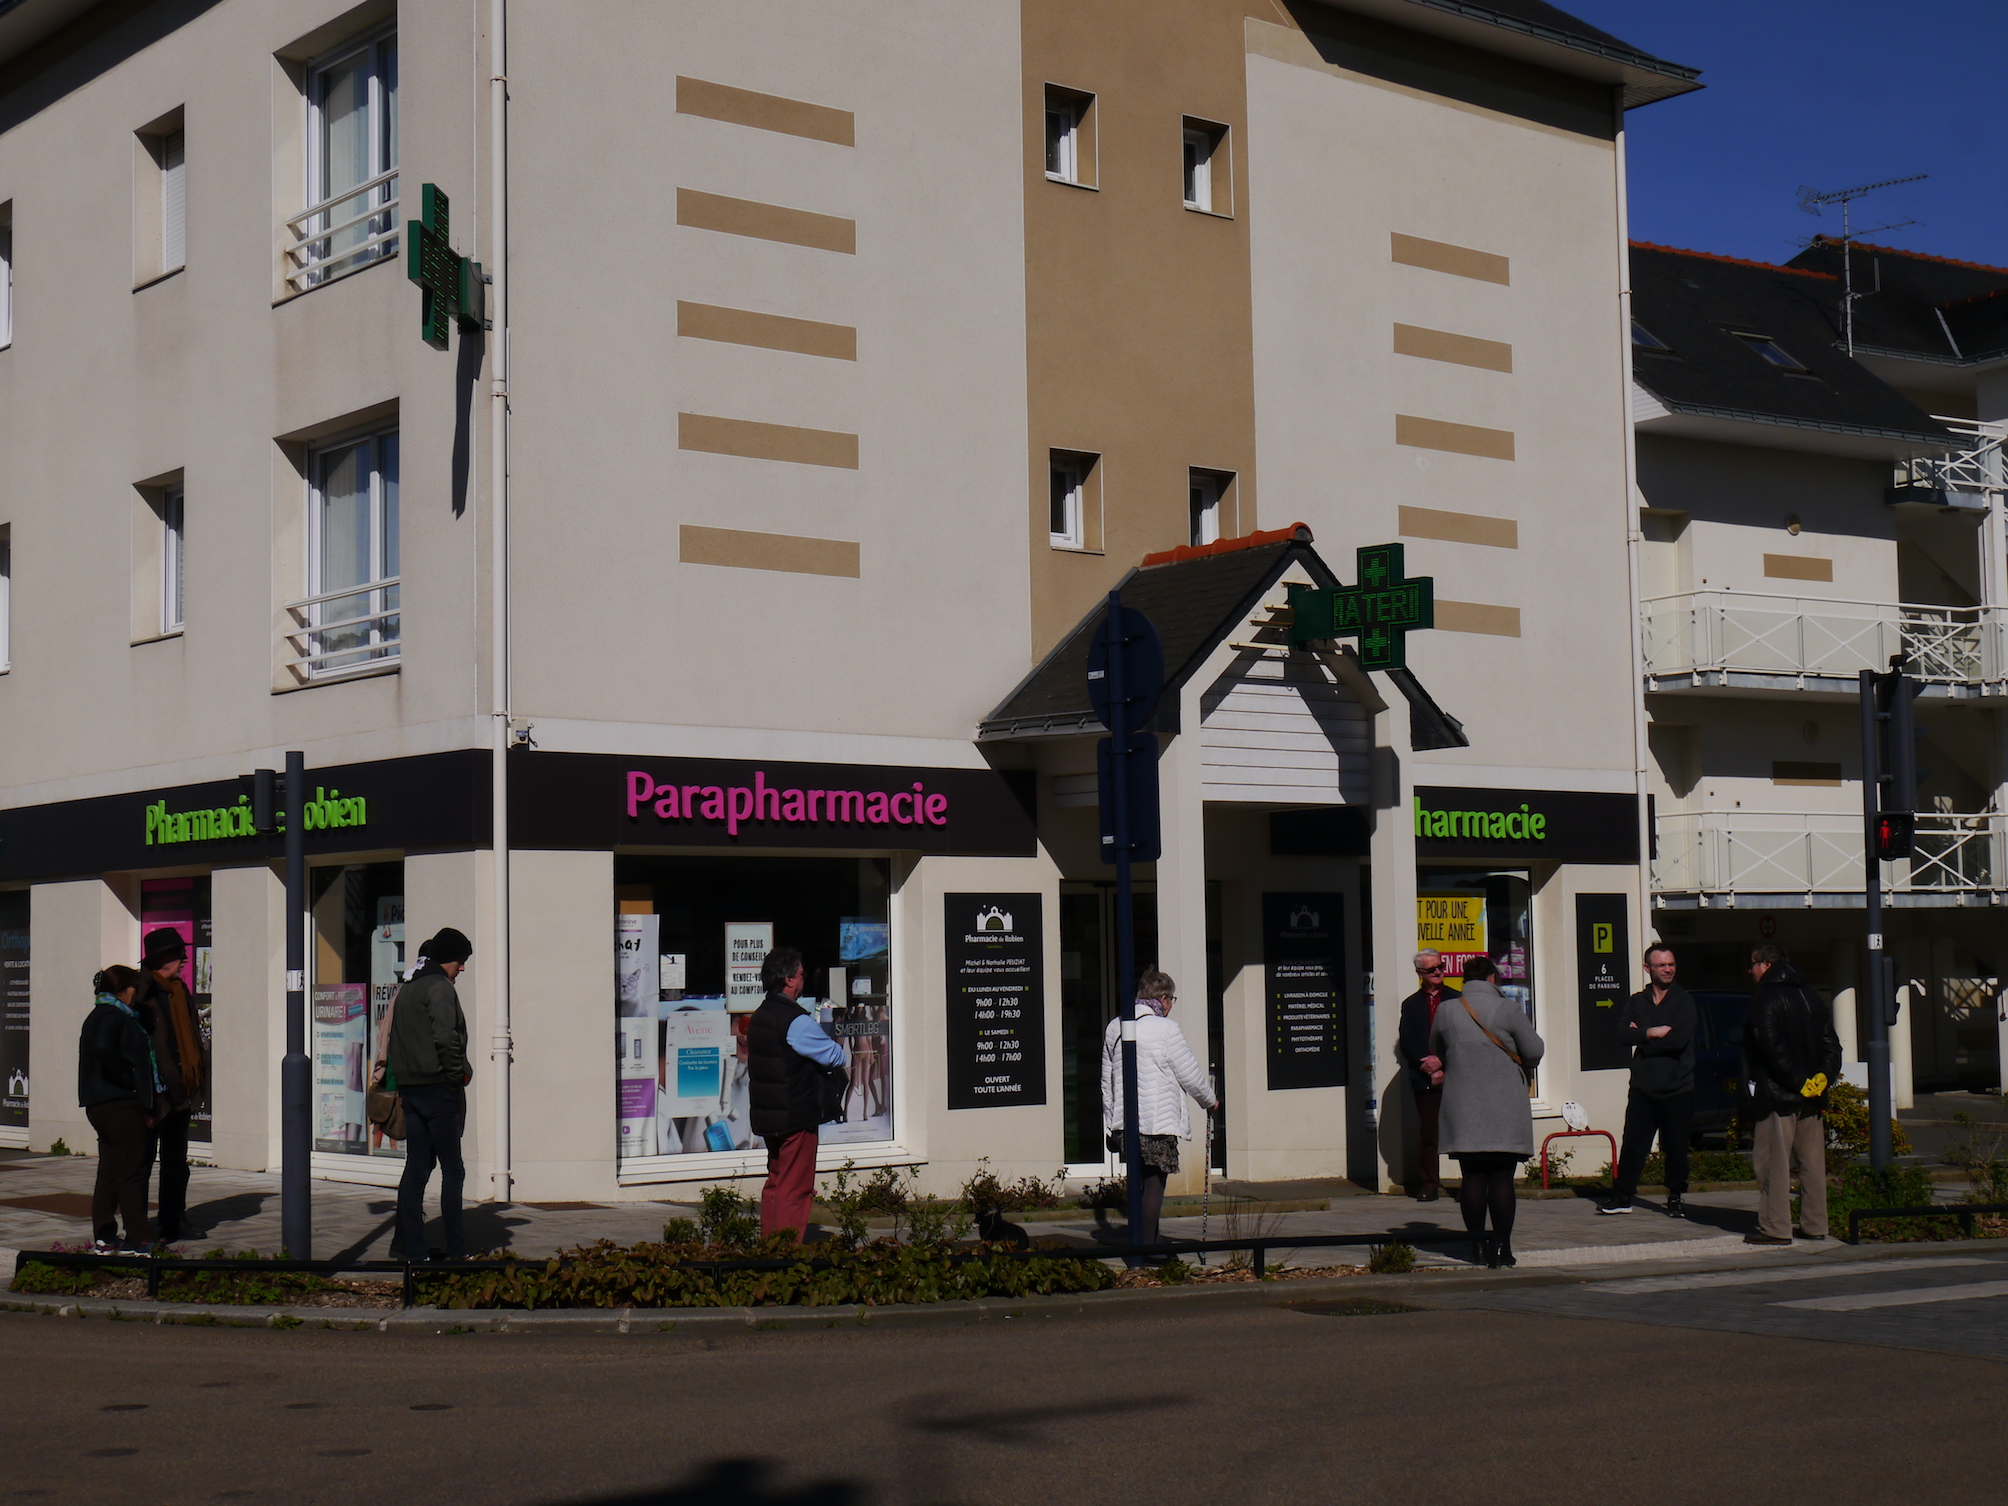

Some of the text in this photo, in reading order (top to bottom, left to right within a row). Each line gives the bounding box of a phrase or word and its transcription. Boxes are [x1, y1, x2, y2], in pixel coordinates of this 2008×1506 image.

[626, 770, 948, 836] Parapharmacie
[145, 794, 260, 846] Pharmacie
[303, 785, 367, 831] obien
[1414, 796, 1547, 841] harmacie
[1426, 900, 1448, 919] POUR
[1451, 900, 1468, 919] UNE
[1418, 919, 1476, 941] UVELLE ANNÉE
[2, 932, 29, 954] Orthop
[964, 934, 998, 943] Pharmacie
[1004, 934, 1024, 942] Robien
[1598, 926, 1608, 950] P
[734, 939, 764, 949] POUR PLUS
[732, 952, 739, 962] DE
[1601, 963, 1607, 975] 6
[733, 973, 762, 982] RENDEZ-VO
[731, 986, 765, 994] AU COMPTOI
[315, 991, 335, 1001] CONFORT
[976, 998, 993, 1007] 9h00
[998, 997, 1019, 1006] 12h30
[974, 1010, 995, 1019] 14h00
[1001, 1009, 1021, 1019] 19h30
[684, 1024, 714, 1034] Avène
[976, 1041, 993, 1050] 9h00
[999, 1040, 1020, 1050] 12h30
[686, 1048, 712, 1056] Cleanance
[975, 1054, 996, 1063] 14h00
[1002, 1052, 1022, 1062] 17h00
[984, 1076, 1010, 1084] OUVERT
[973, 1083, 1022, 1094] TOUTE L'ANNÉE
